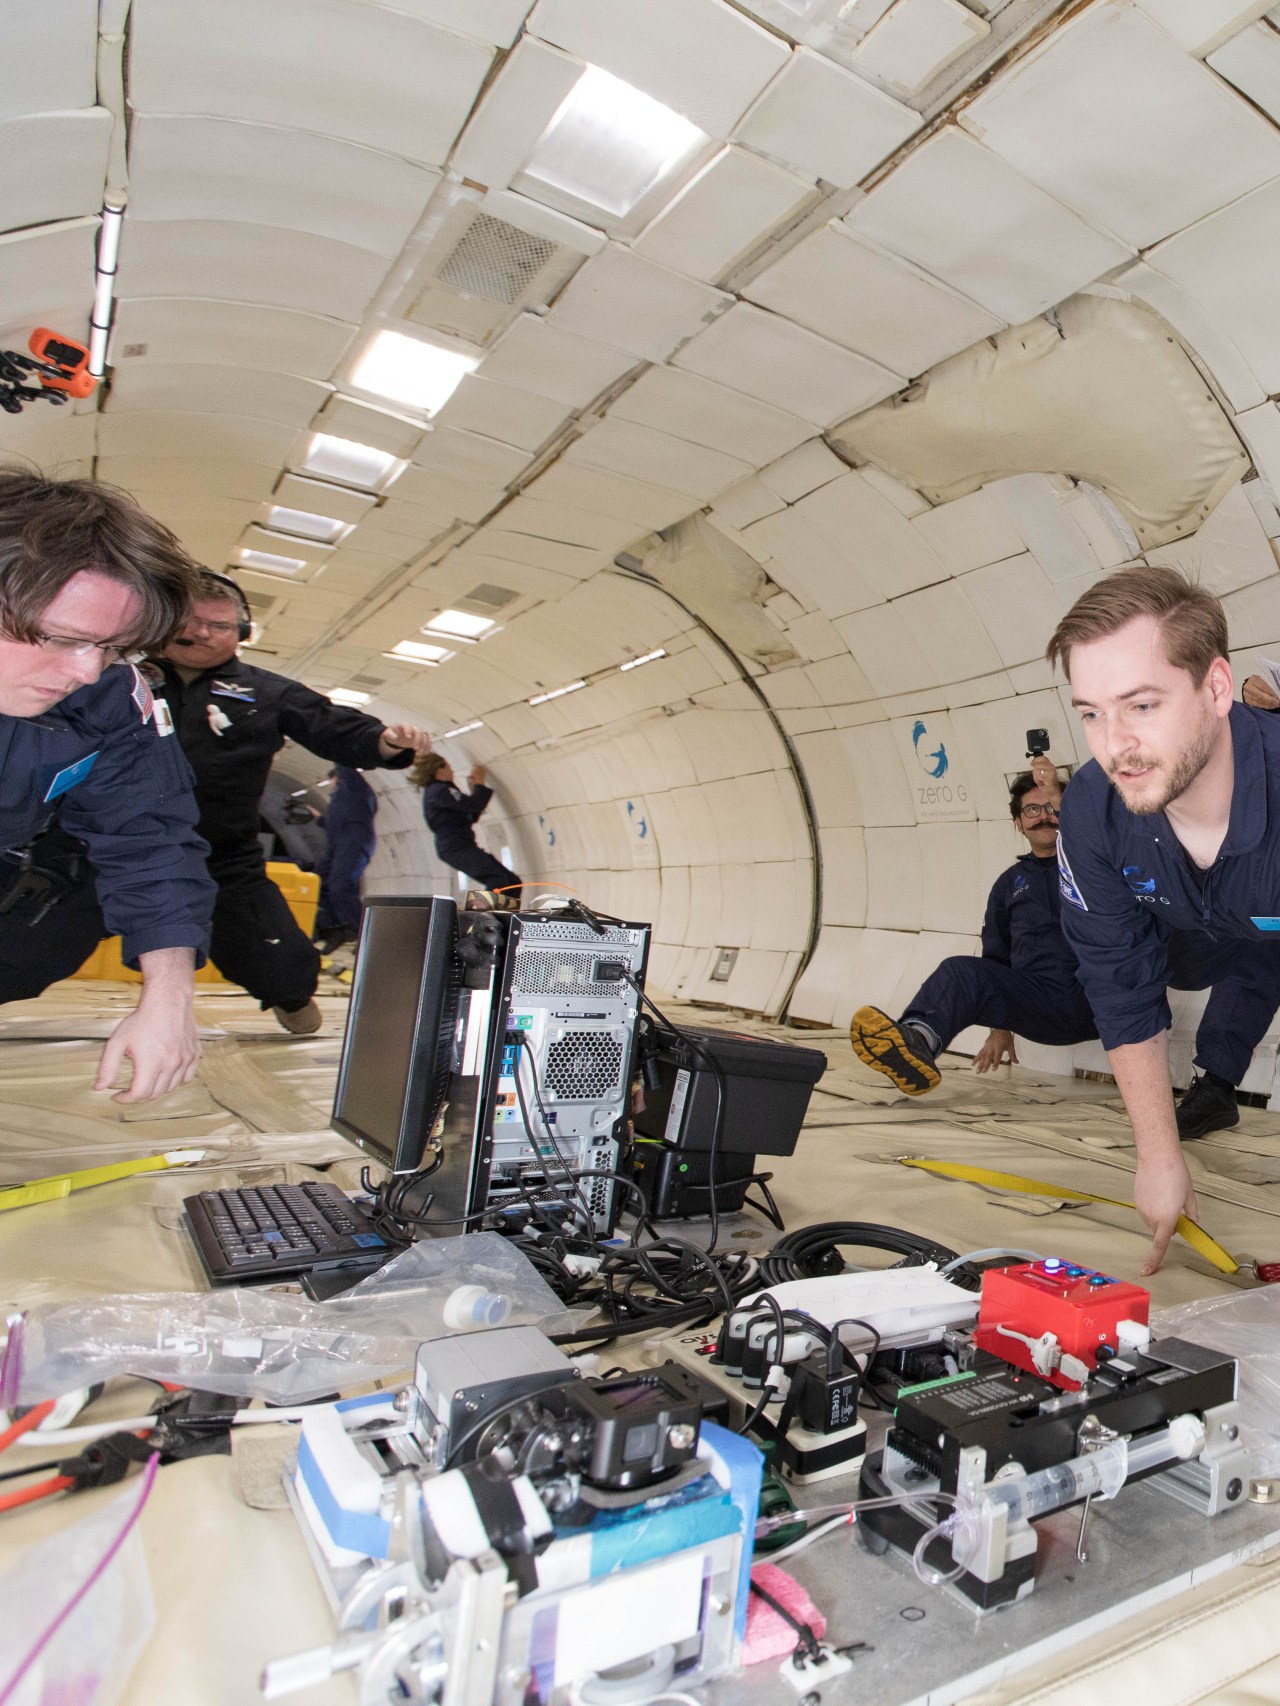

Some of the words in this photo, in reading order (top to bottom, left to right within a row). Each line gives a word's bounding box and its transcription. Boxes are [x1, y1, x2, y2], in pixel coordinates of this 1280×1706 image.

[917, 786, 953, 804] zero
[957, 784, 967, 802] G
[1135, 894, 1156, 903] ro
[1160, 896, 1171, 905] G
